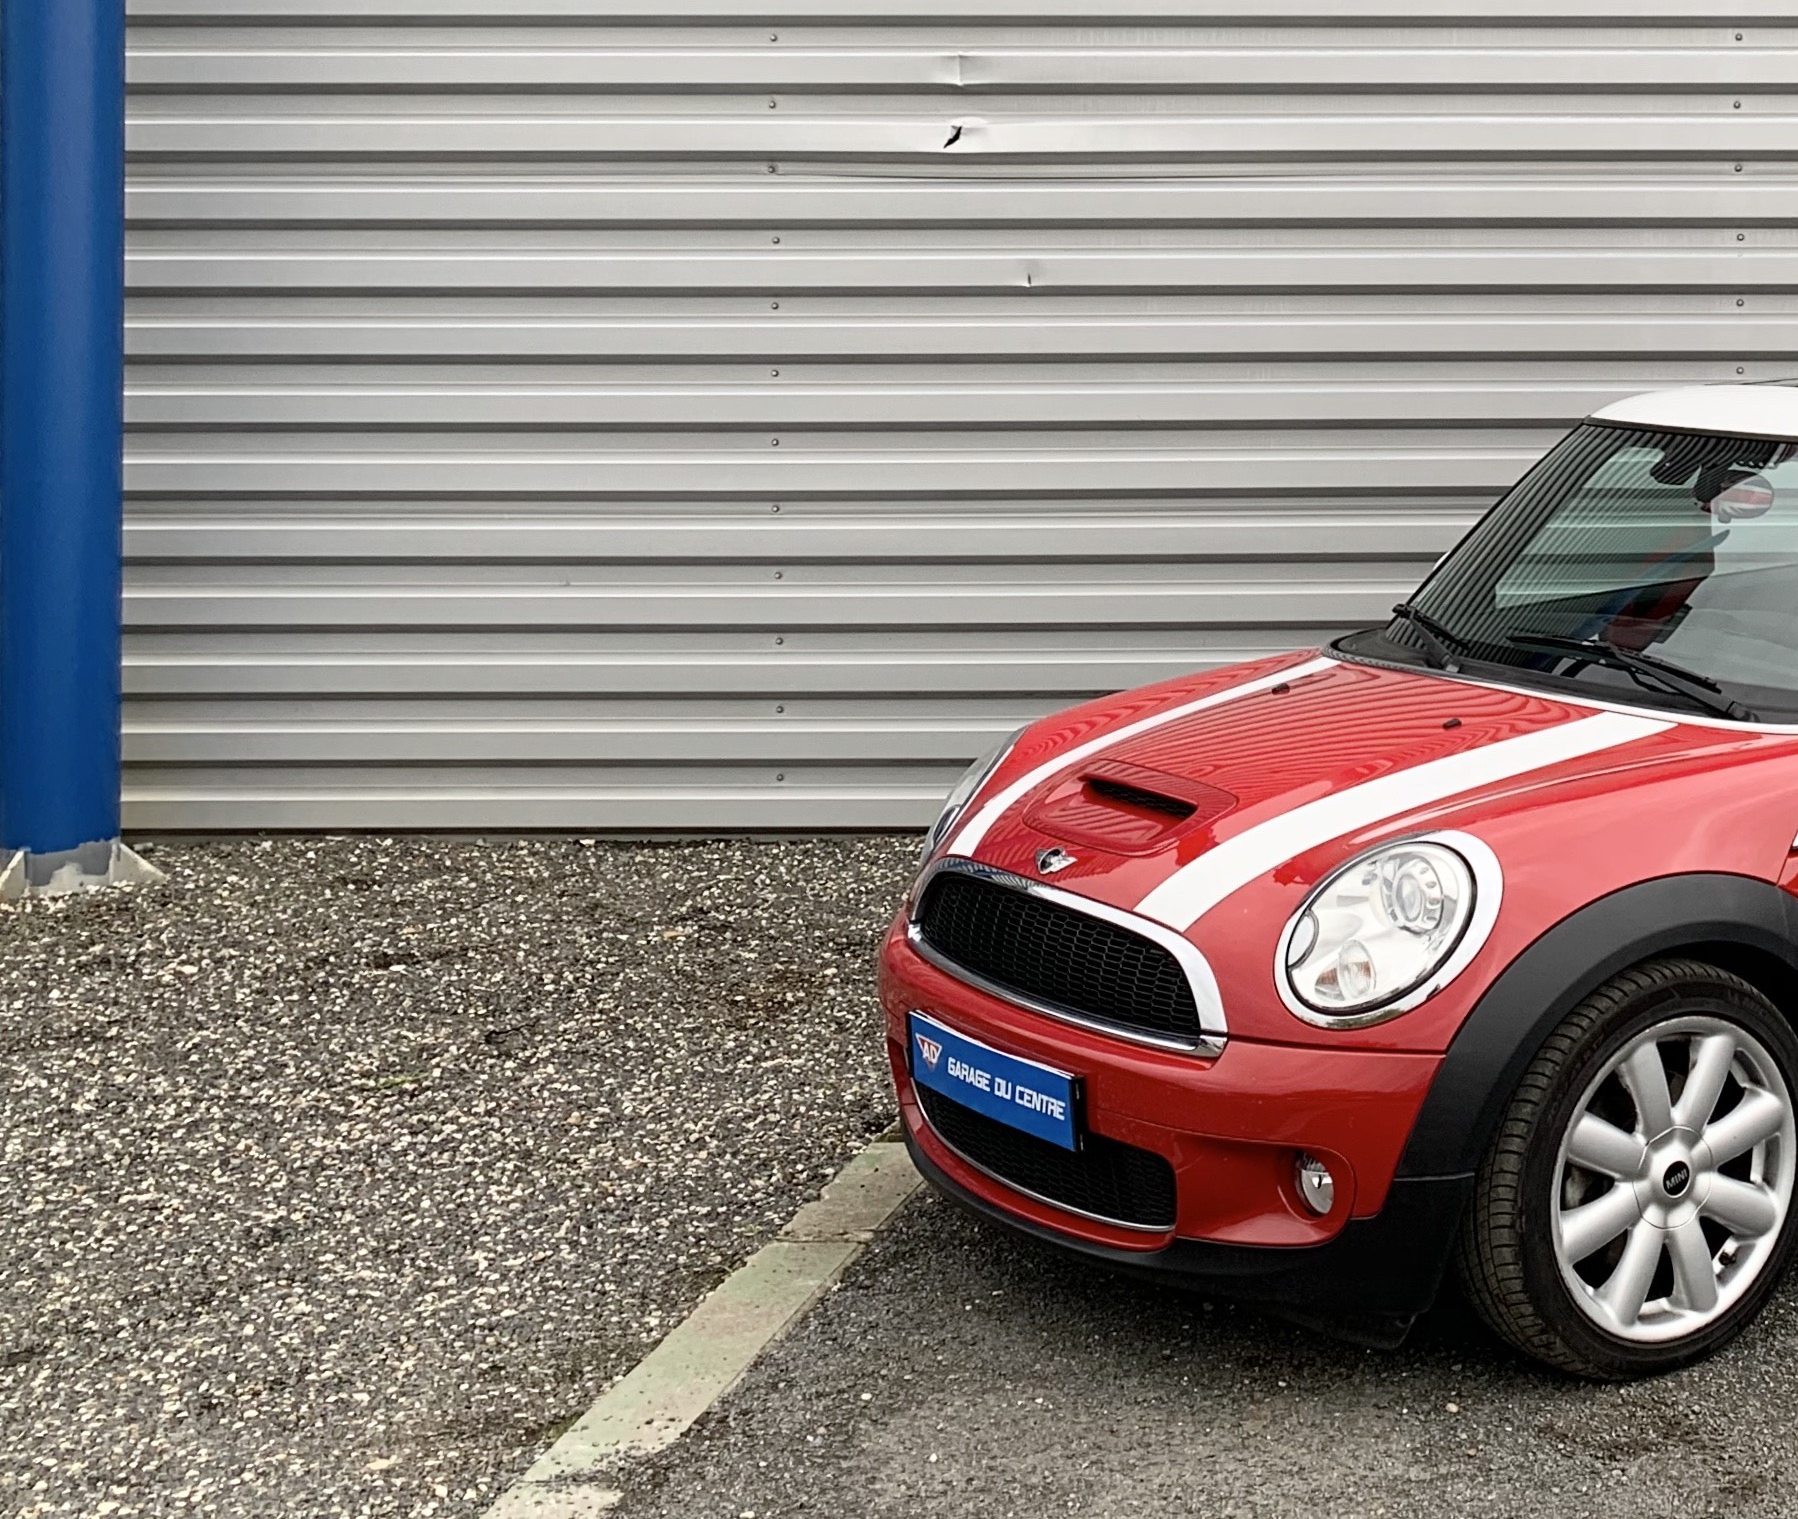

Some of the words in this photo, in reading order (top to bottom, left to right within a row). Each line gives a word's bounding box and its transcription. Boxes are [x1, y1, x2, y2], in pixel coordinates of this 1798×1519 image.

[922, 1042, 938, 1064] AD
[948, 1057, 991, 1092] GARAGE
[994, 1077, 1012, 1100] DU
[1015, 1085, 1066, 1121] CENTRE
[1665, 1168, 1688, 1190] MINI
